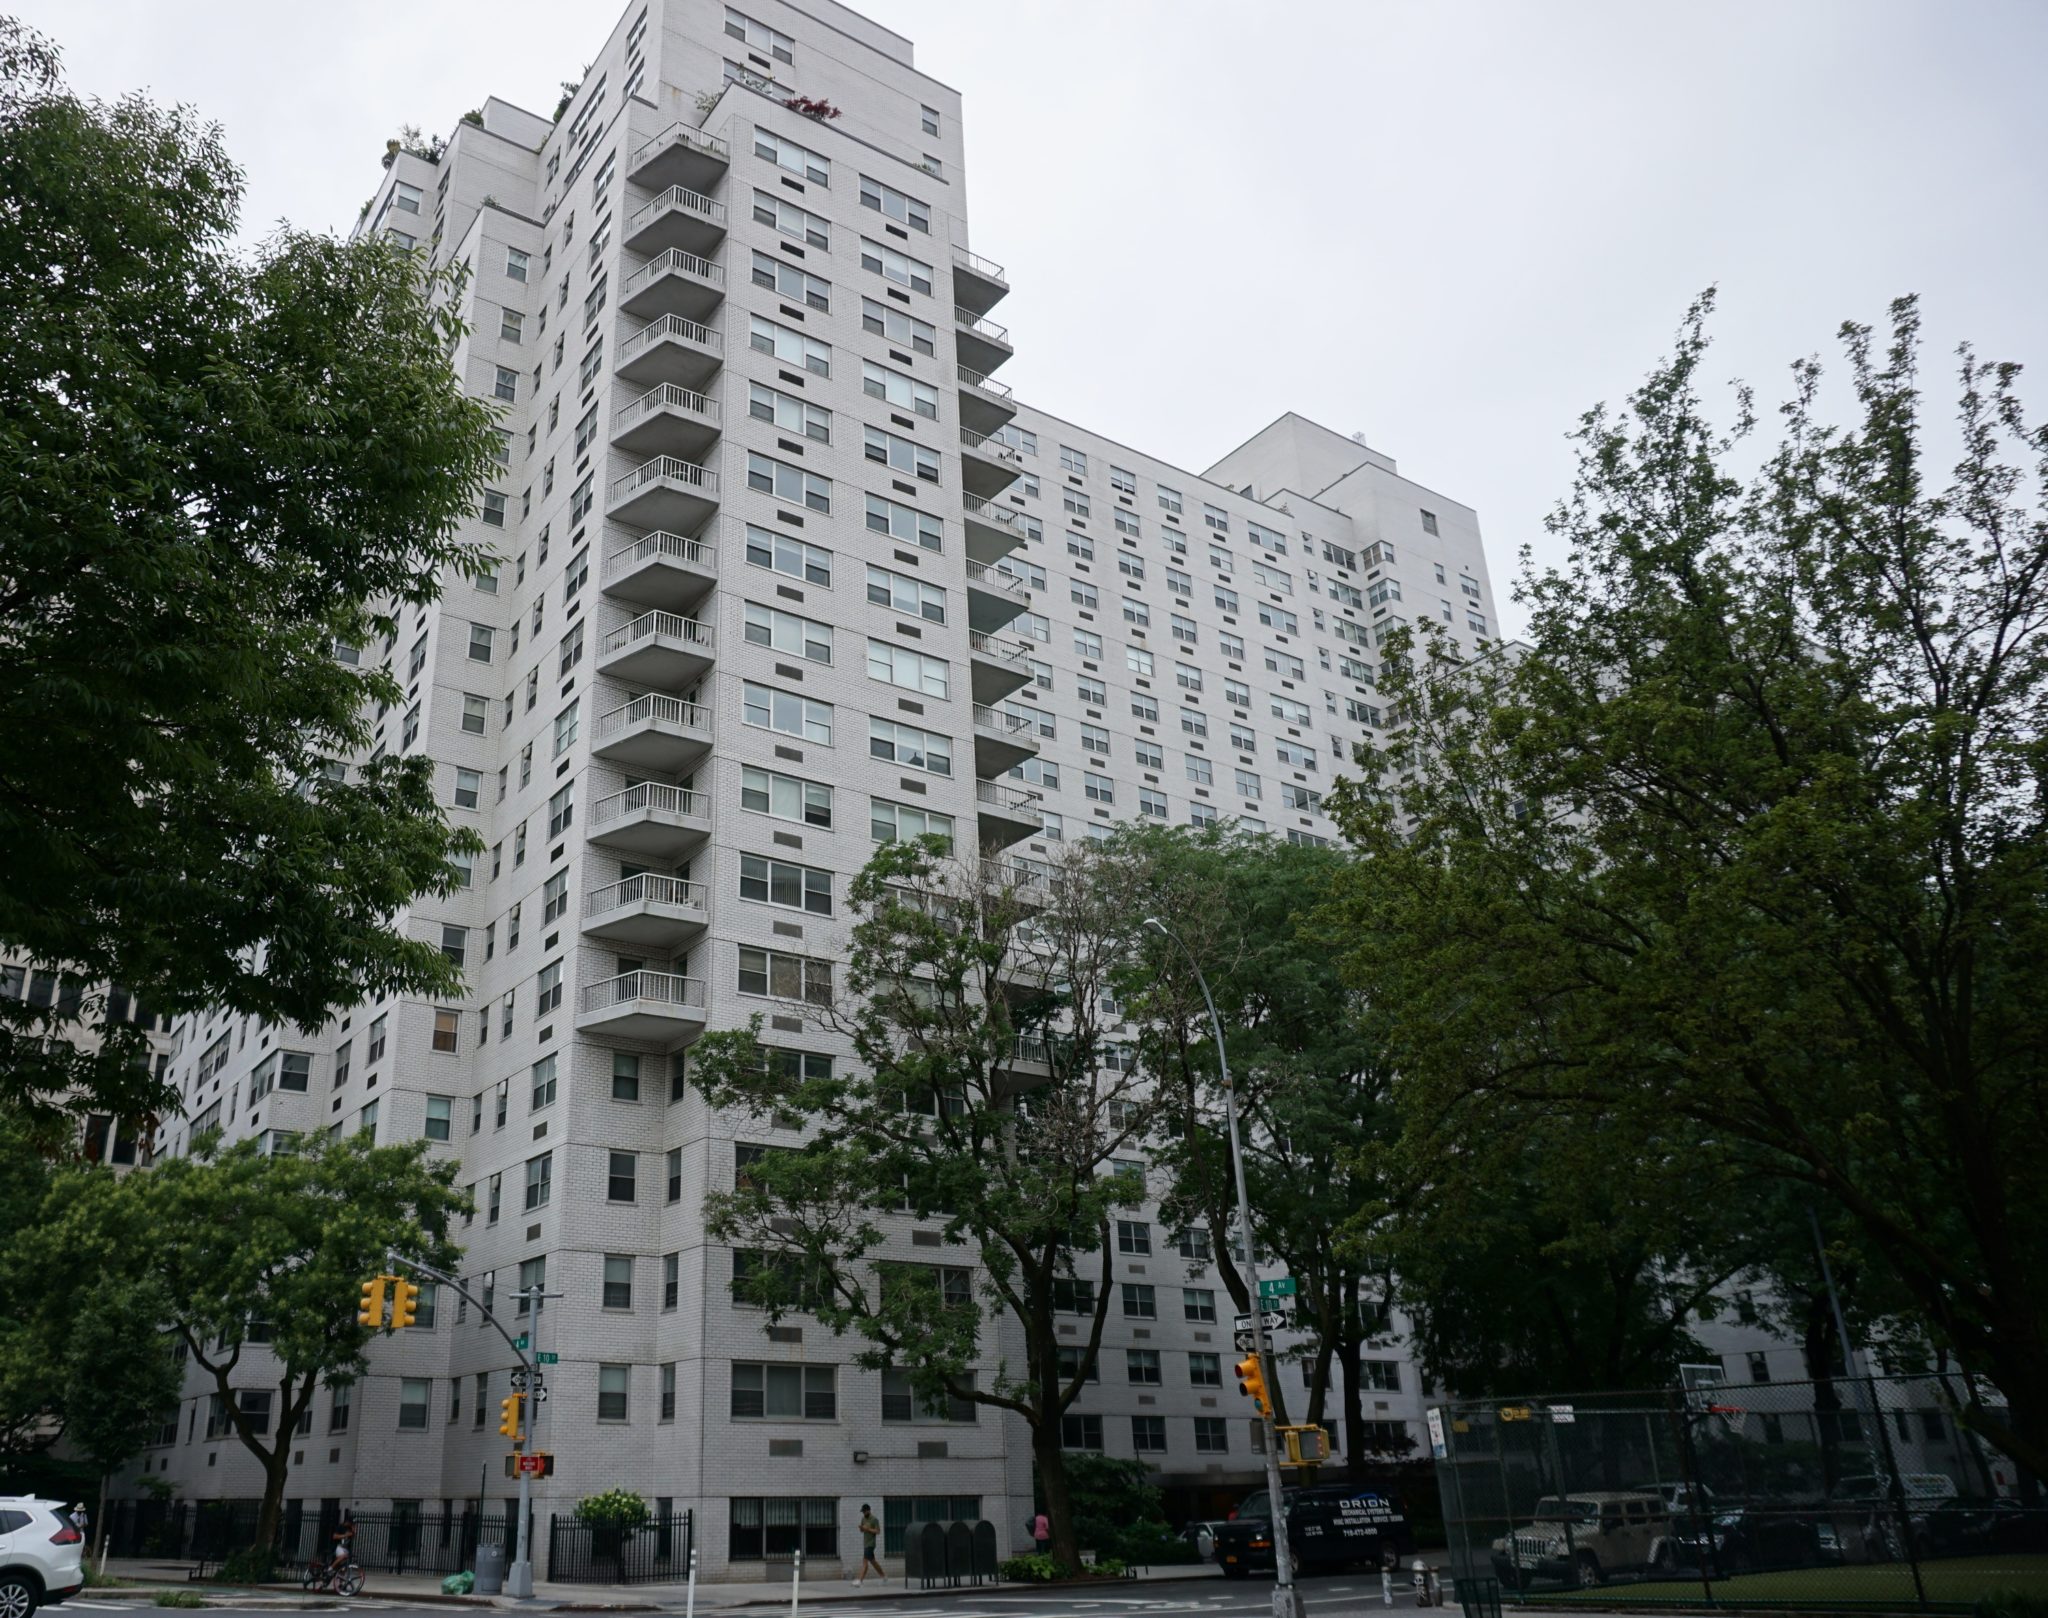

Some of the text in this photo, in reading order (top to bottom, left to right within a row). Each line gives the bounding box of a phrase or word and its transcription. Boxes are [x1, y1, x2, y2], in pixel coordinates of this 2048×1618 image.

[1268, 1281, 1286, 1294] 4 AV
[1241, 1316, 1279, 1329] ON WAY
[537, 1353, 542, 1362] E
[543, 1354, 550, 1363] 10
[1339, 1499, 1390, 1508] ORION
[1341, 1508, 1367, 1516] MECHANICAL
[1366, 1507, 1385, 1515] SYSTEMS
